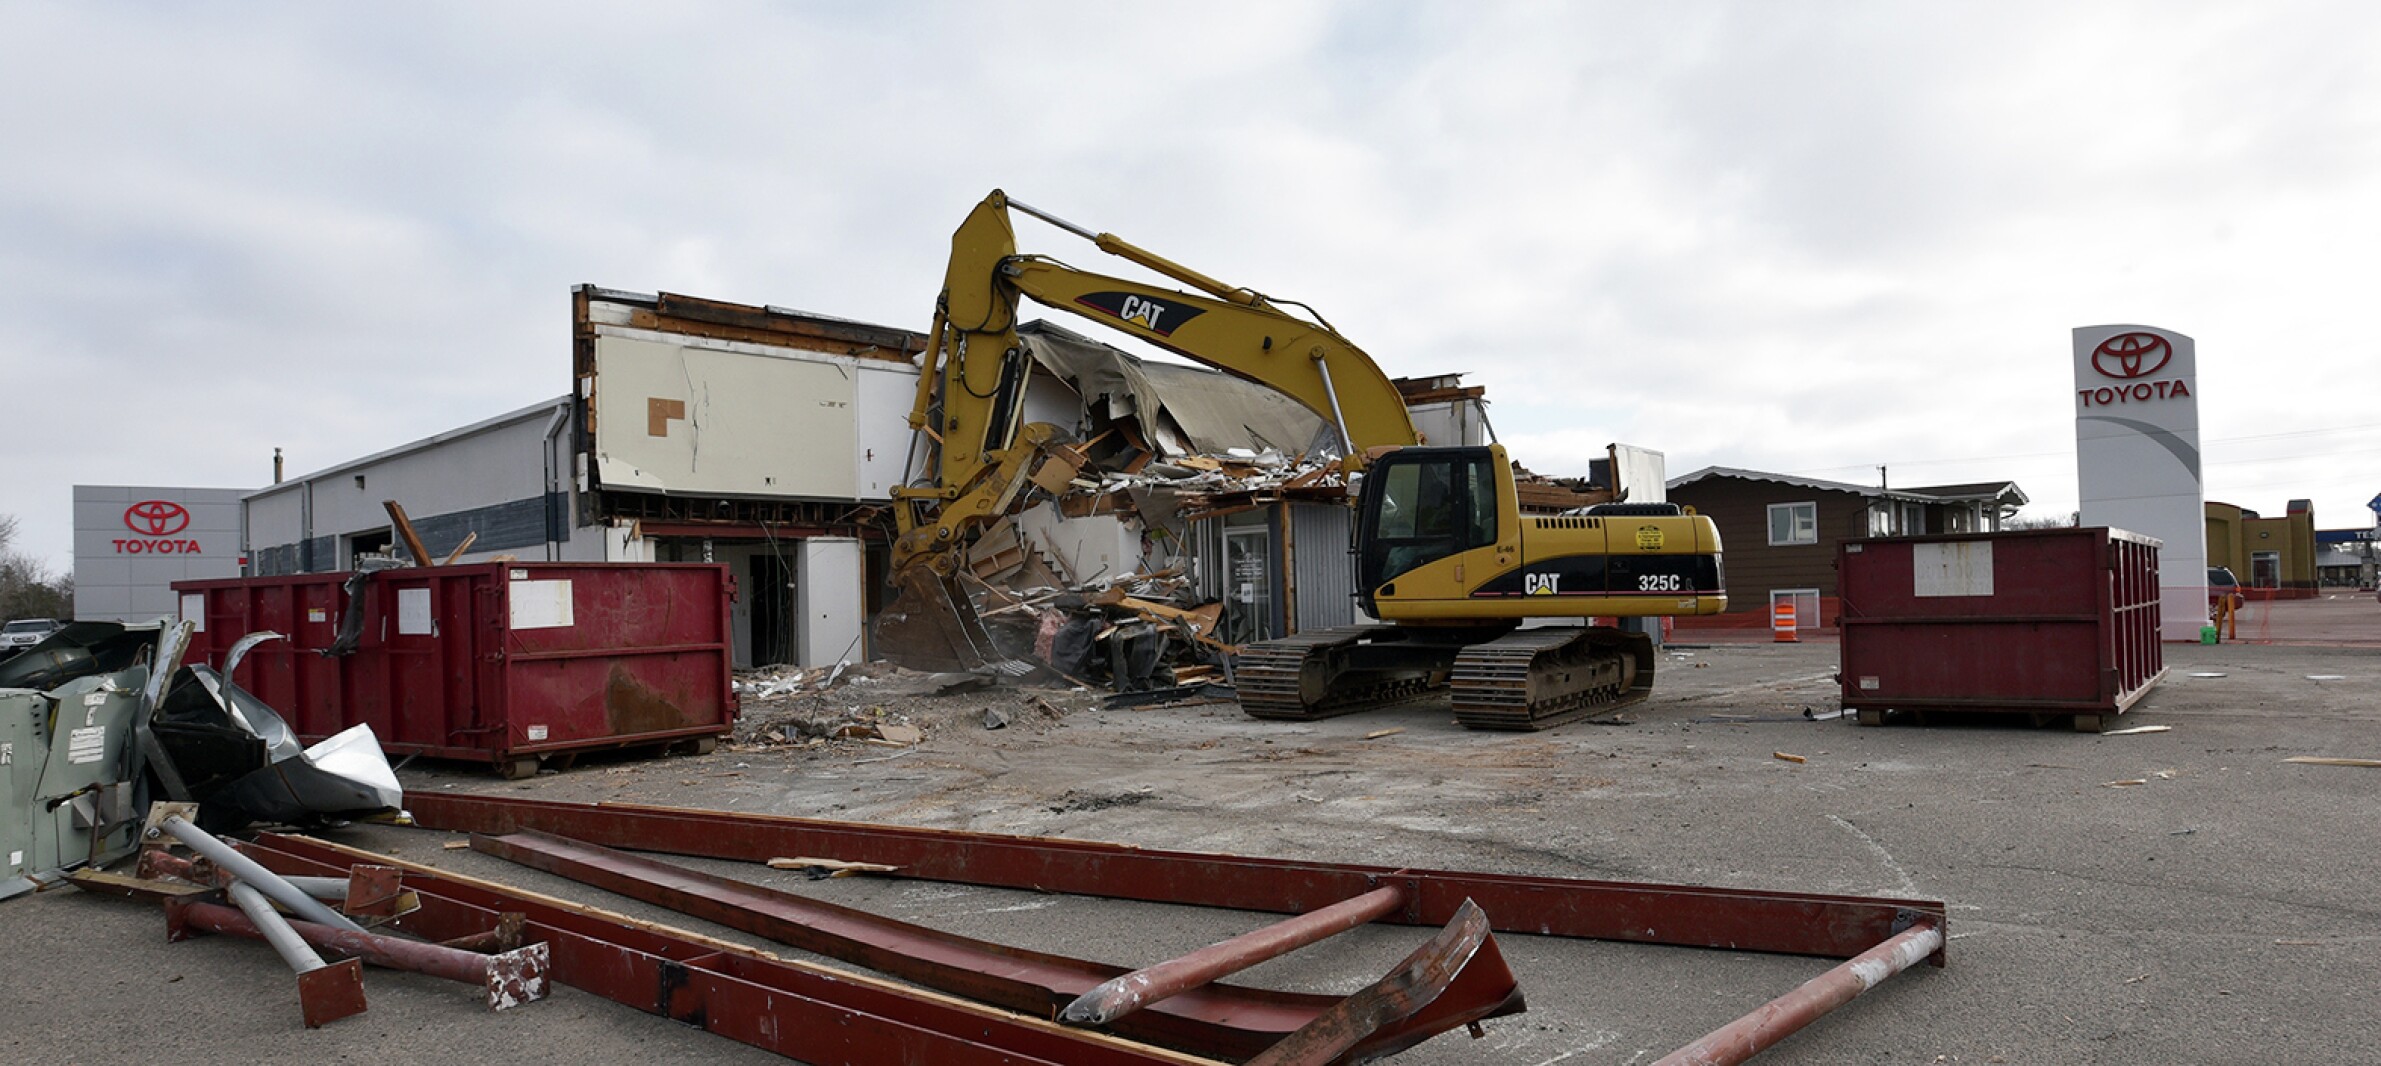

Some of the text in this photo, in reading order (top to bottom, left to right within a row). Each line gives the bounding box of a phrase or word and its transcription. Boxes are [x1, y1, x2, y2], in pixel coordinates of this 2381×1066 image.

[1121, 295, 1164, 330] CAT
[2079, 380, 2190, 407] TOYOTA
[112, 539, 201, 553] TOYOTA
[1525, 573, 1560, 595] CAT
[1639, 574, 1680, 591] 325C
